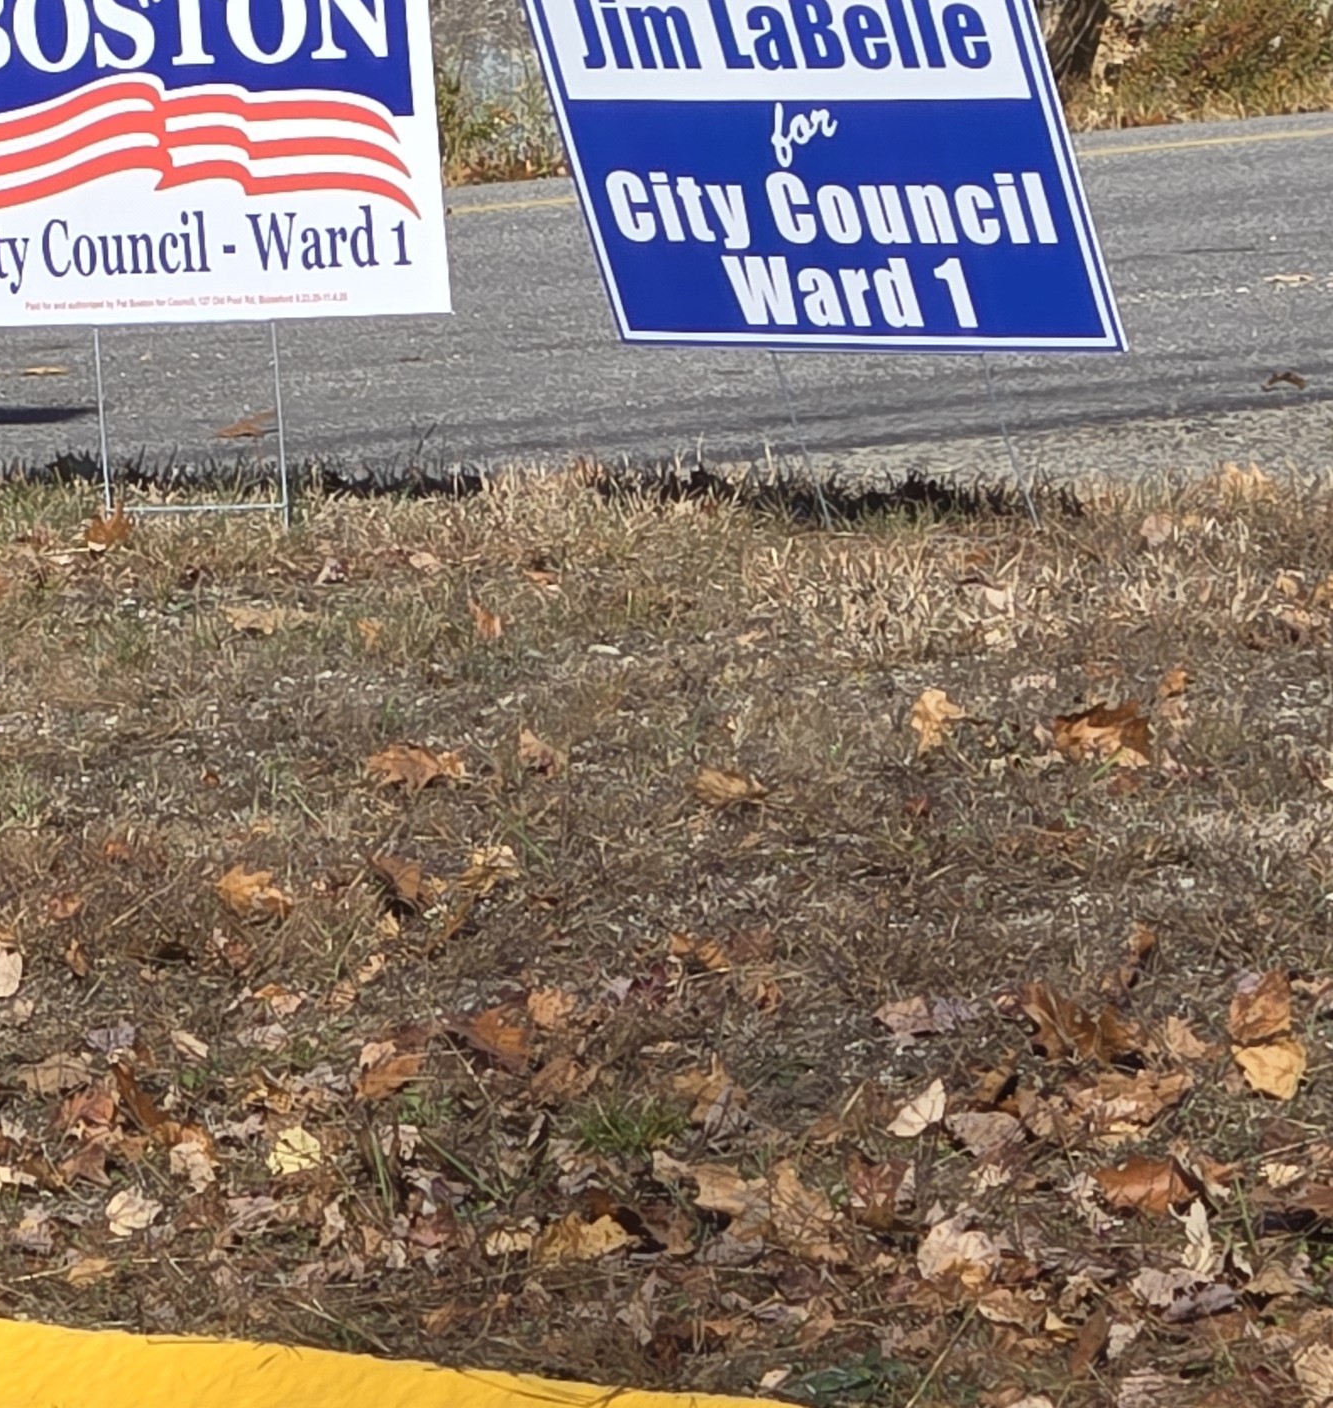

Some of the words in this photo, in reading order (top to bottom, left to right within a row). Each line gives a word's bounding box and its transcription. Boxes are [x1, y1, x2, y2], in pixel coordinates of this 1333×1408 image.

[771, 102, 838, 168] for
[41, 210, 211, 278] Council
[245, 204, 378, 271] Ward
[391, 220, 413, 266] 1
[605, 169, 751, 250] City
[765, 170, 1060, 245] Council
[721, 255, 924, 329] Ward
[934, 257, 979, 329] 1
